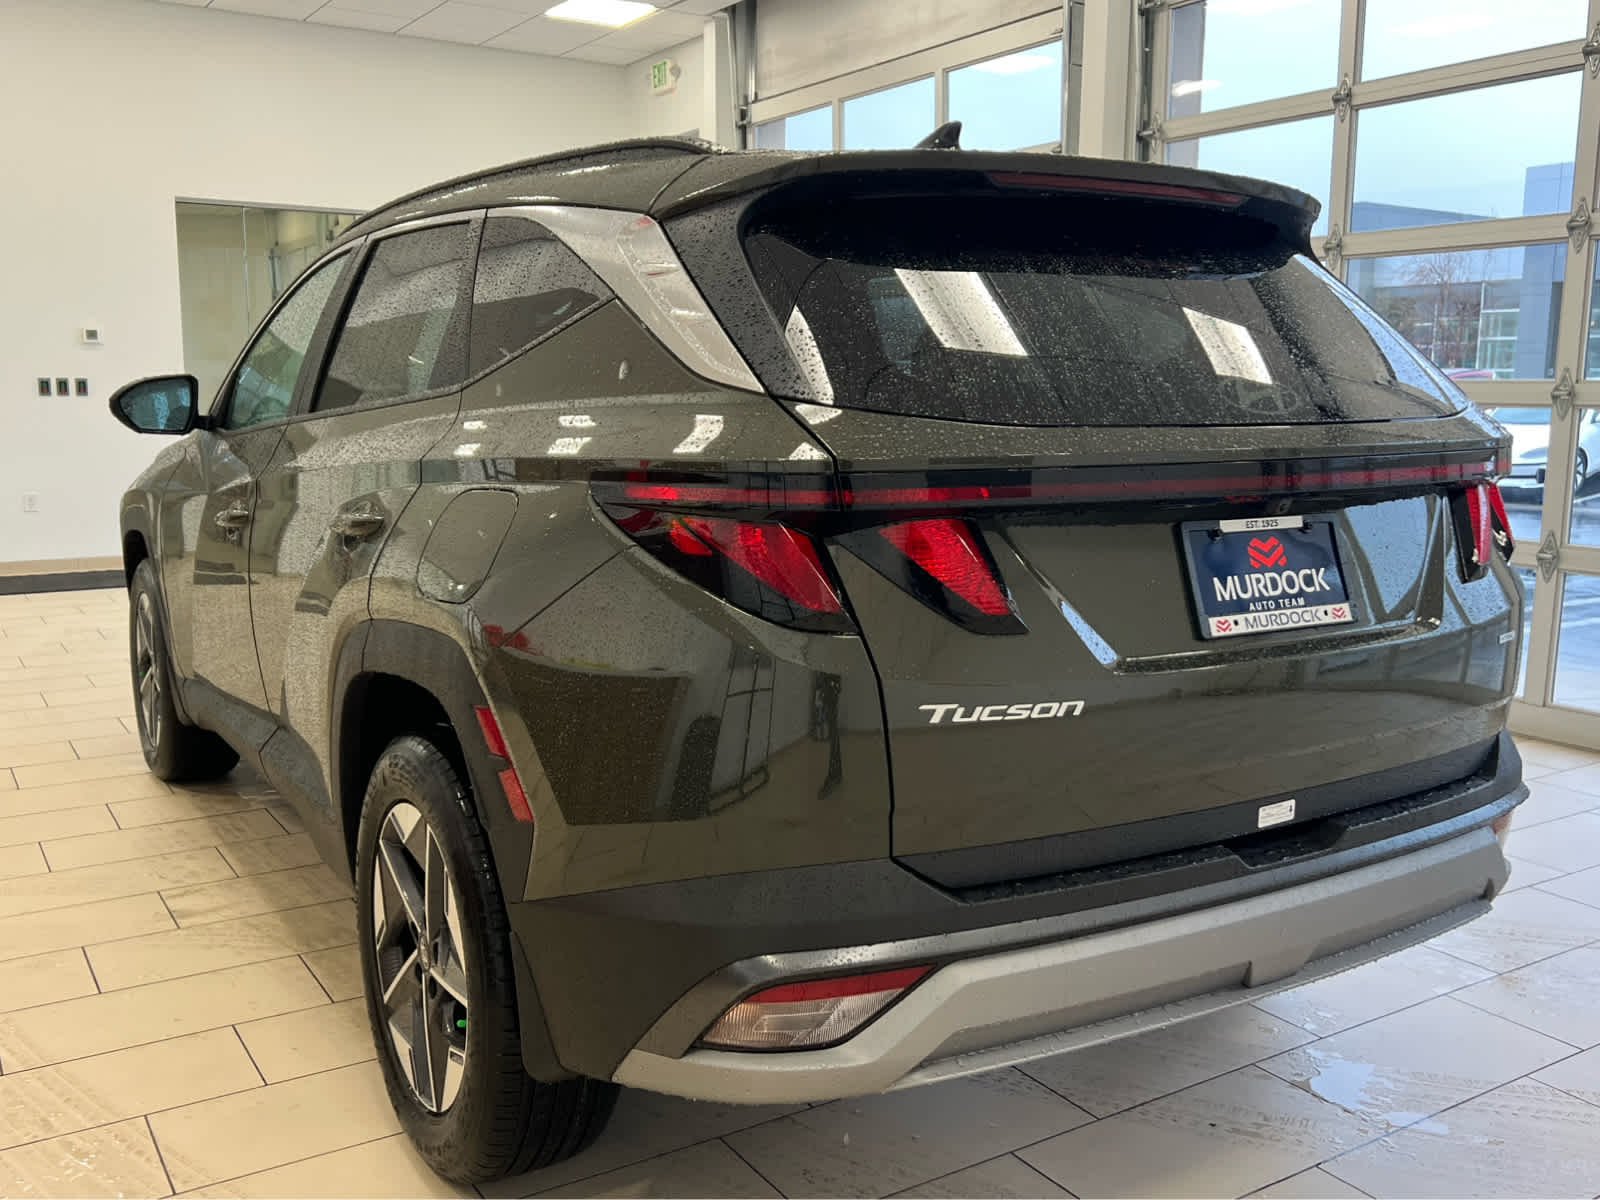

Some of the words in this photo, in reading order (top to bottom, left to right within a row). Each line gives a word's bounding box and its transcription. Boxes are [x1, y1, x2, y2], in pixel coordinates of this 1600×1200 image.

[652, 60, 667, 88] EXIT
[1262, 519, 1279, 528] 1925
[1213, 567, 1330, 601] MURDOCK
[1249, 600, 1275, 611] AUTO
[1278, 597, 1305, 608] TEAM
[1245, 608, 1322, 630] MURDOCK
